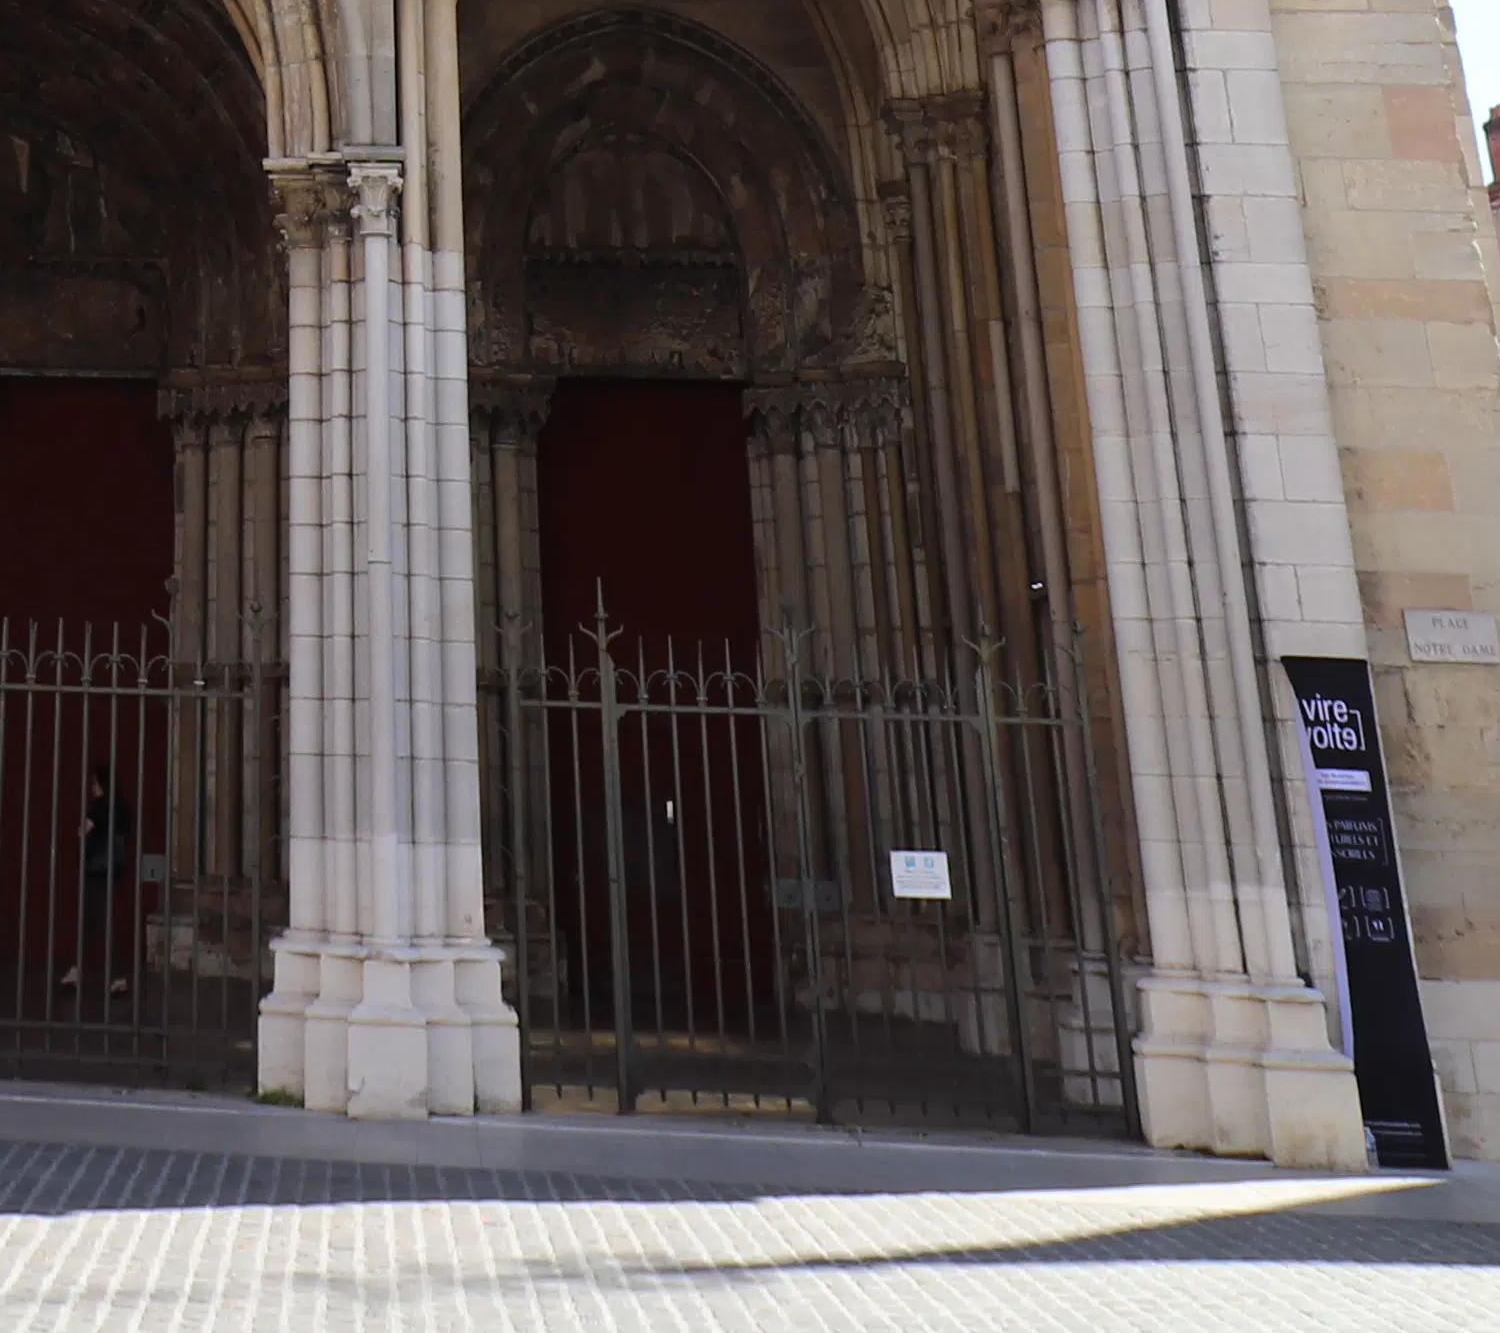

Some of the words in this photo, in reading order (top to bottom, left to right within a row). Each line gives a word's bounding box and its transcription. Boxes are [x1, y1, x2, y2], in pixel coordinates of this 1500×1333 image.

[1431, 616, 1470, 630] PLACE
[1413, 641, 1453, 656] NOTRE
[1462, 643, 1497, 657] DAME
[1301, 692, 1349, 723] vire
